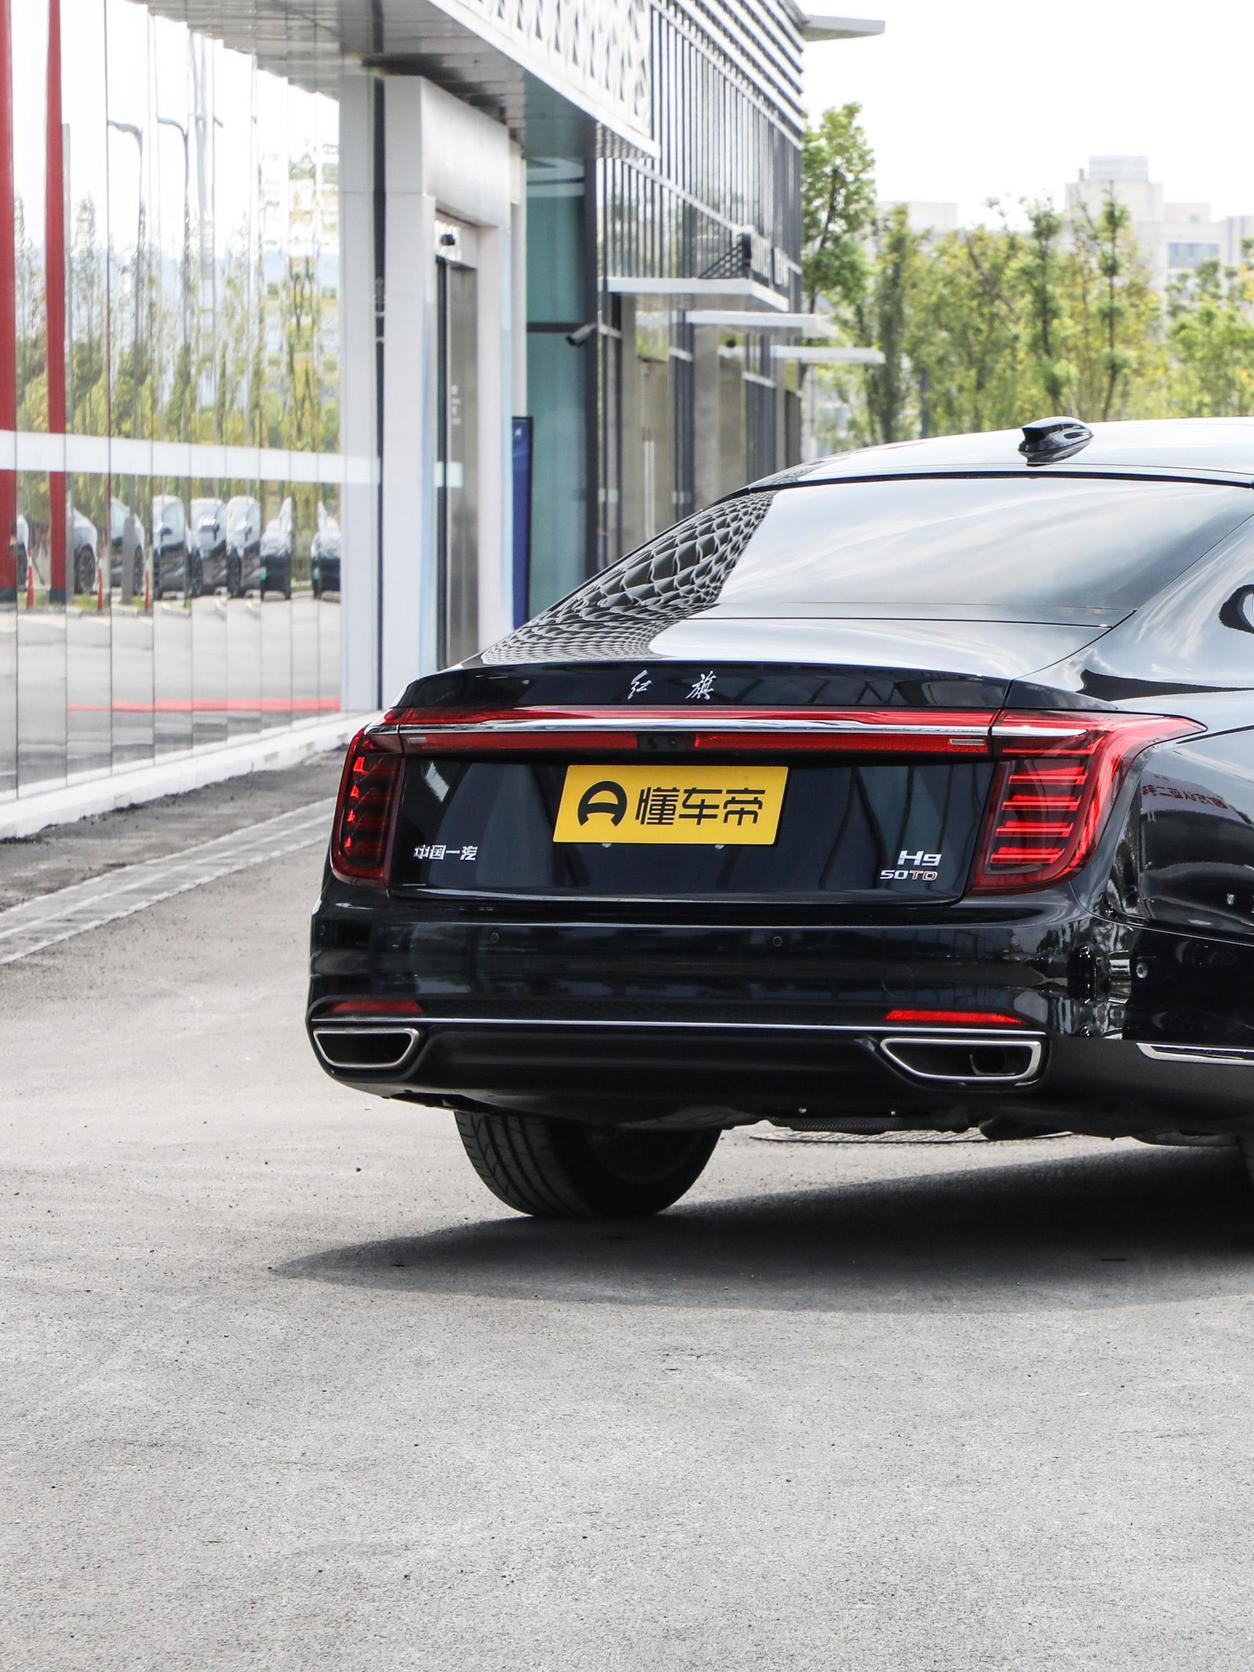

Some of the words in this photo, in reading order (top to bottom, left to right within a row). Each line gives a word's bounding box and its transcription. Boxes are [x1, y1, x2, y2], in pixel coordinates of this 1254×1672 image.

[635, 787, 766, 826] 懂车帝
[413, 844, 478, 861] 中国一汽
[897, 850, 942, 867] H9
[879, 869, 938, 881] 50TD
